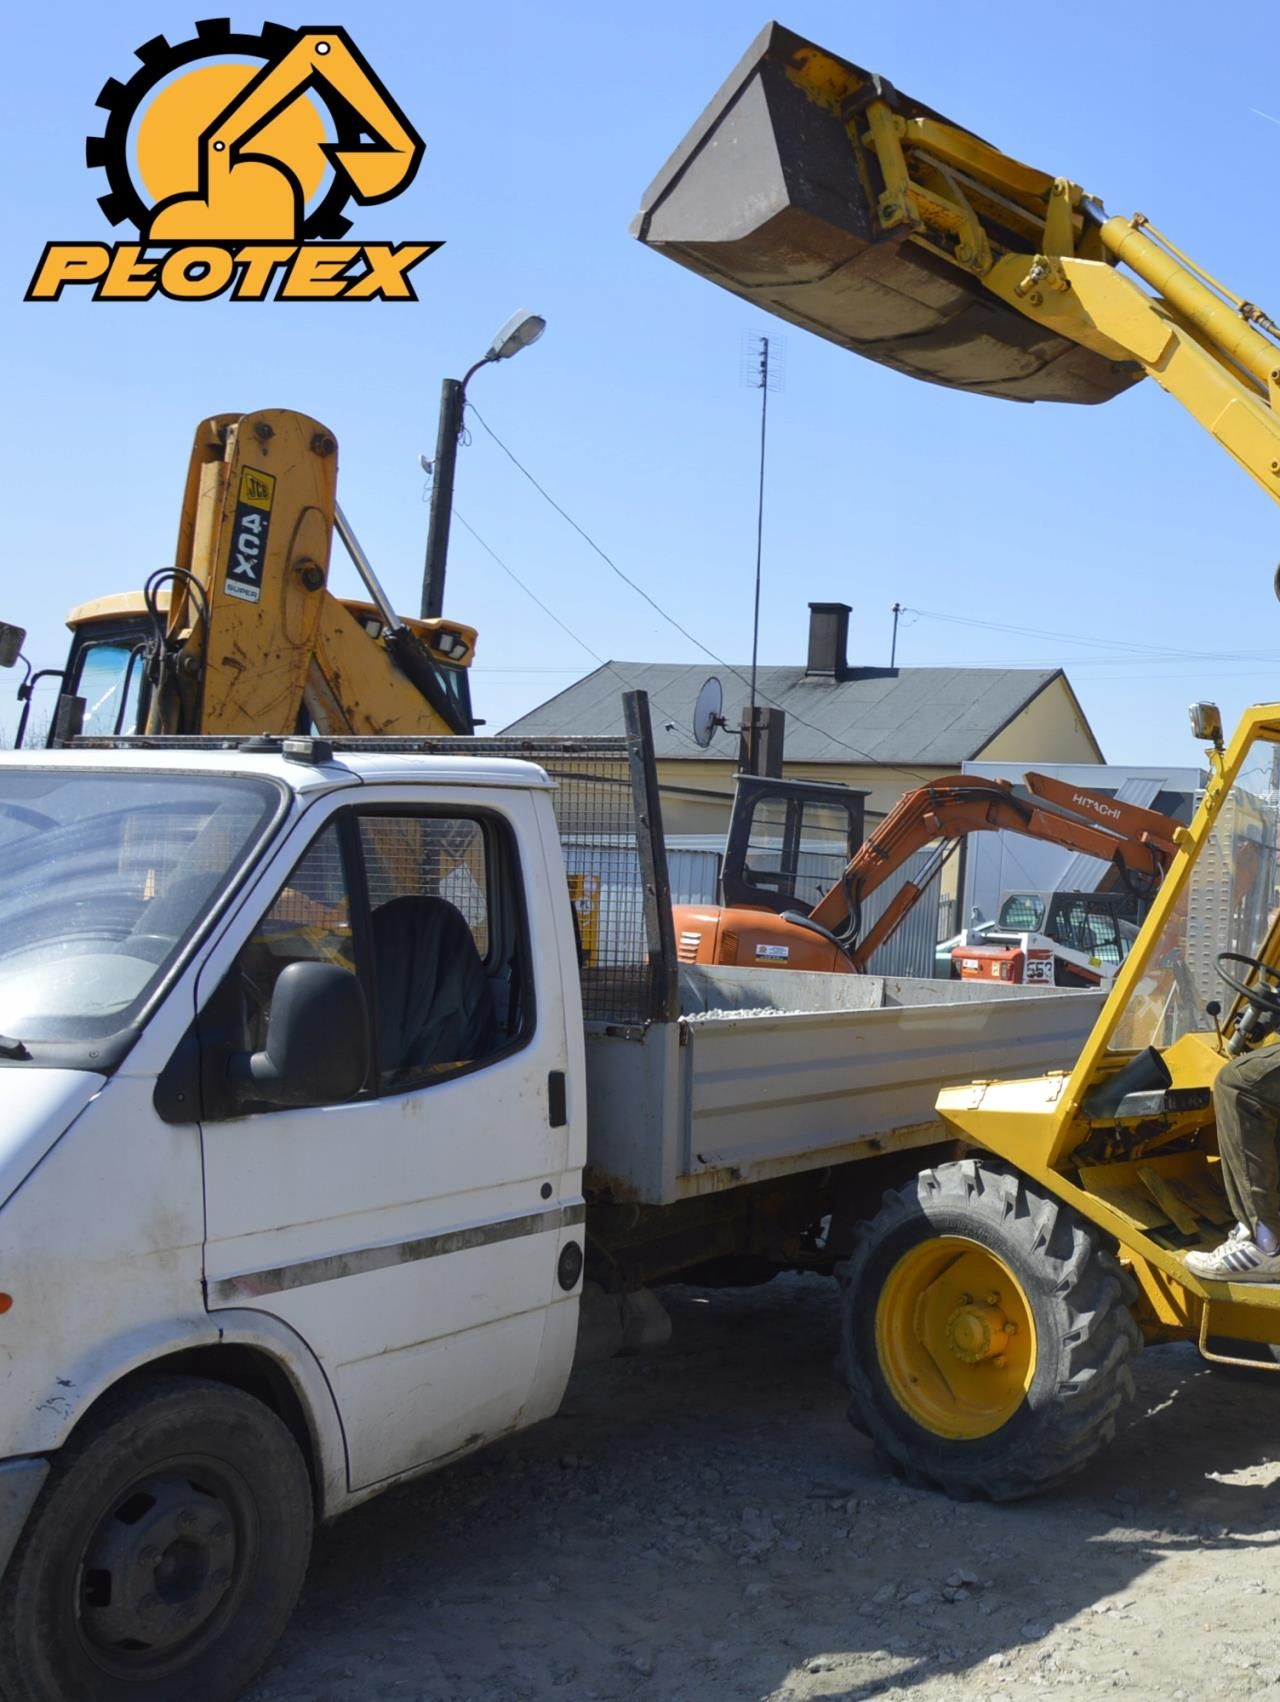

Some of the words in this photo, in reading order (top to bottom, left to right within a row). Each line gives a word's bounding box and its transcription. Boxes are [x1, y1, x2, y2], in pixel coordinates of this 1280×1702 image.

[232, 513, 262, 579] 4CX
[227, 583, 258, 598] SUPER
[1072, 793, 1121, 819] HITACHI
